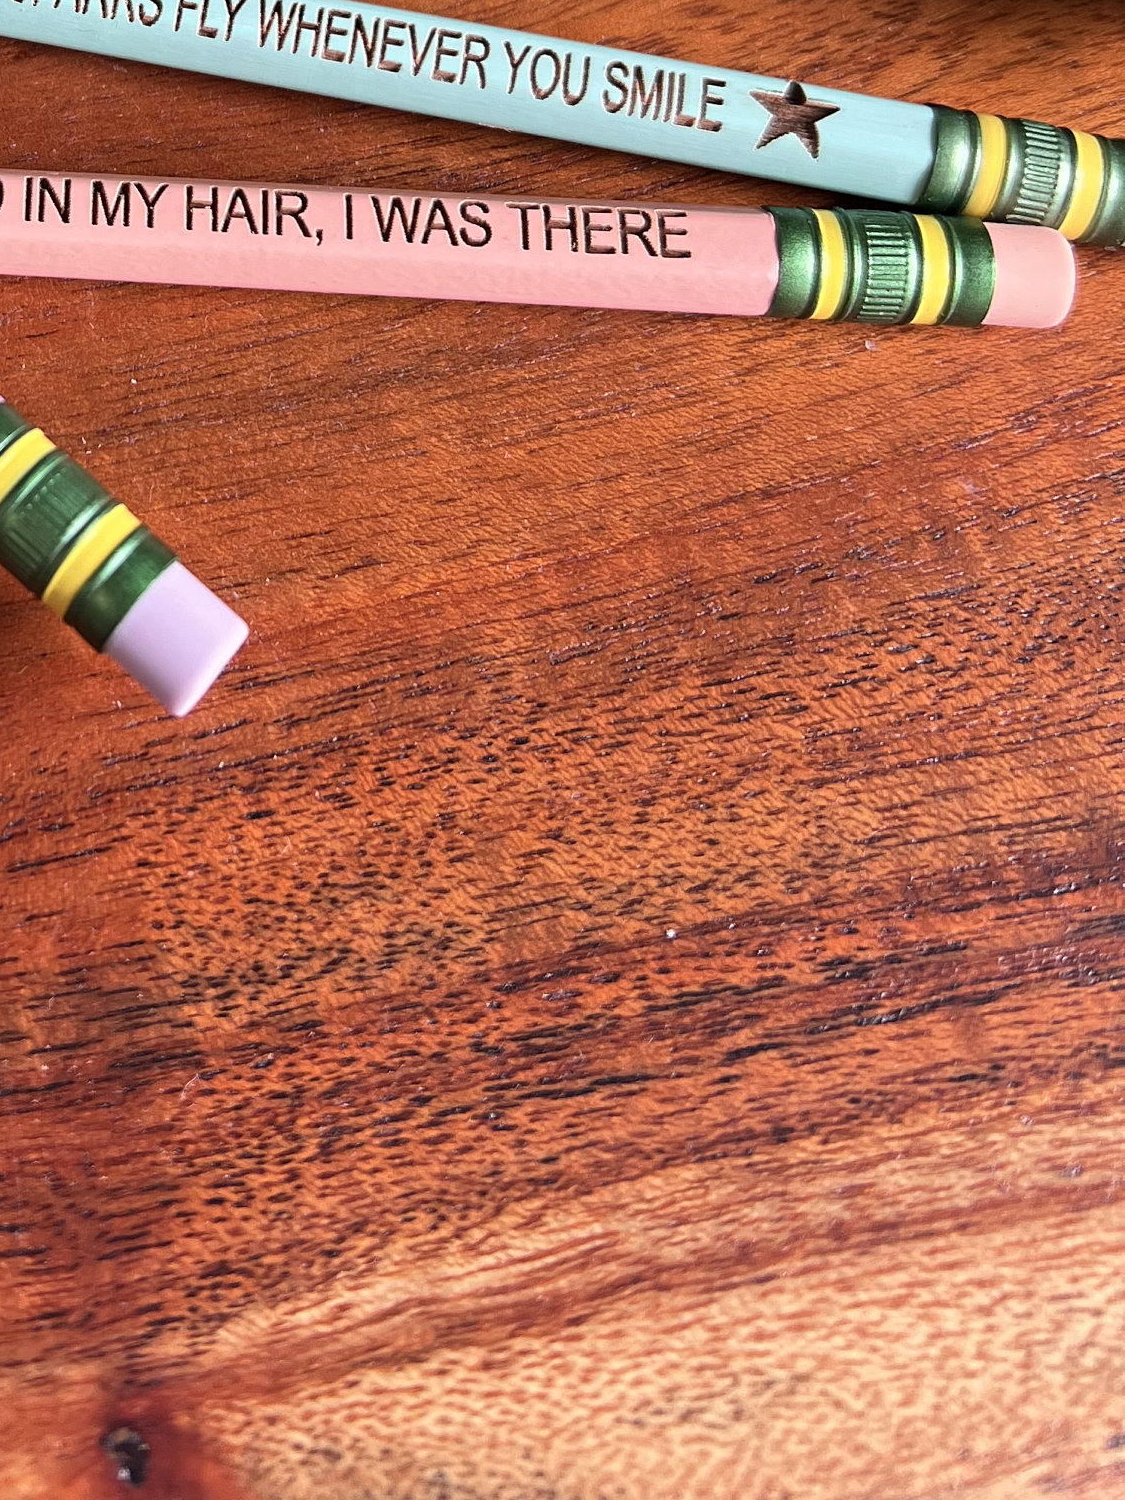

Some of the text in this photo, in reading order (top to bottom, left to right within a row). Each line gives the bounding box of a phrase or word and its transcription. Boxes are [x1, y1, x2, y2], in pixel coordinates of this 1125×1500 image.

[503, 39, 591, 106] YOU
[602, 60, 727, 133] SMILE
[23, 175, 72, 225] IN
[91, 179, 169, 229] MY
[185, 183, 324, 246] HAIR,
[343, 192, 354, 240] I
[369, 193, 493, 248] WAS
[504, 201, 692, 259] THERE
